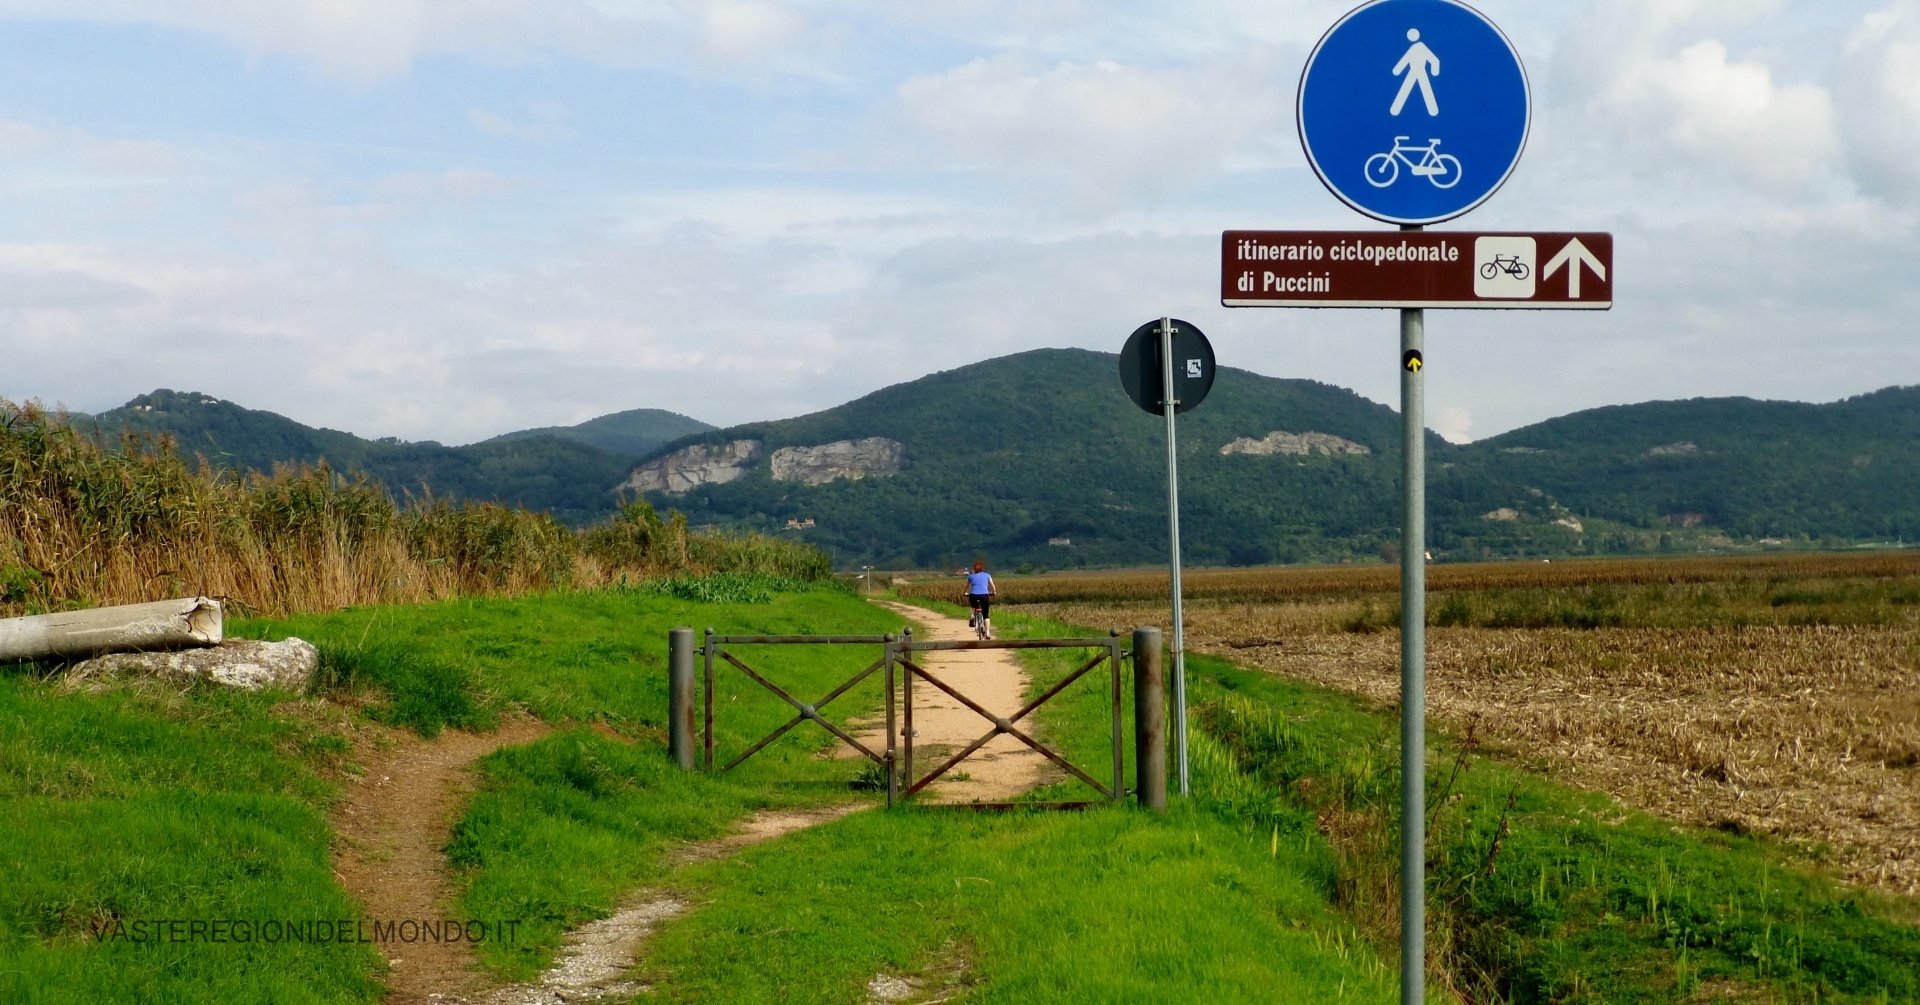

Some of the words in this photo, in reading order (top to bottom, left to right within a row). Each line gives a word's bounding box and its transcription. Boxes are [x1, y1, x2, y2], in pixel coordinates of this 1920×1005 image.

[1237, 239, 1324, 262] itinerario
[1330, 240, 1459, 266] ciclopedonale
[1237, 271, 1254, 292] di
[1263, 271, 1330, 293] Puccini
